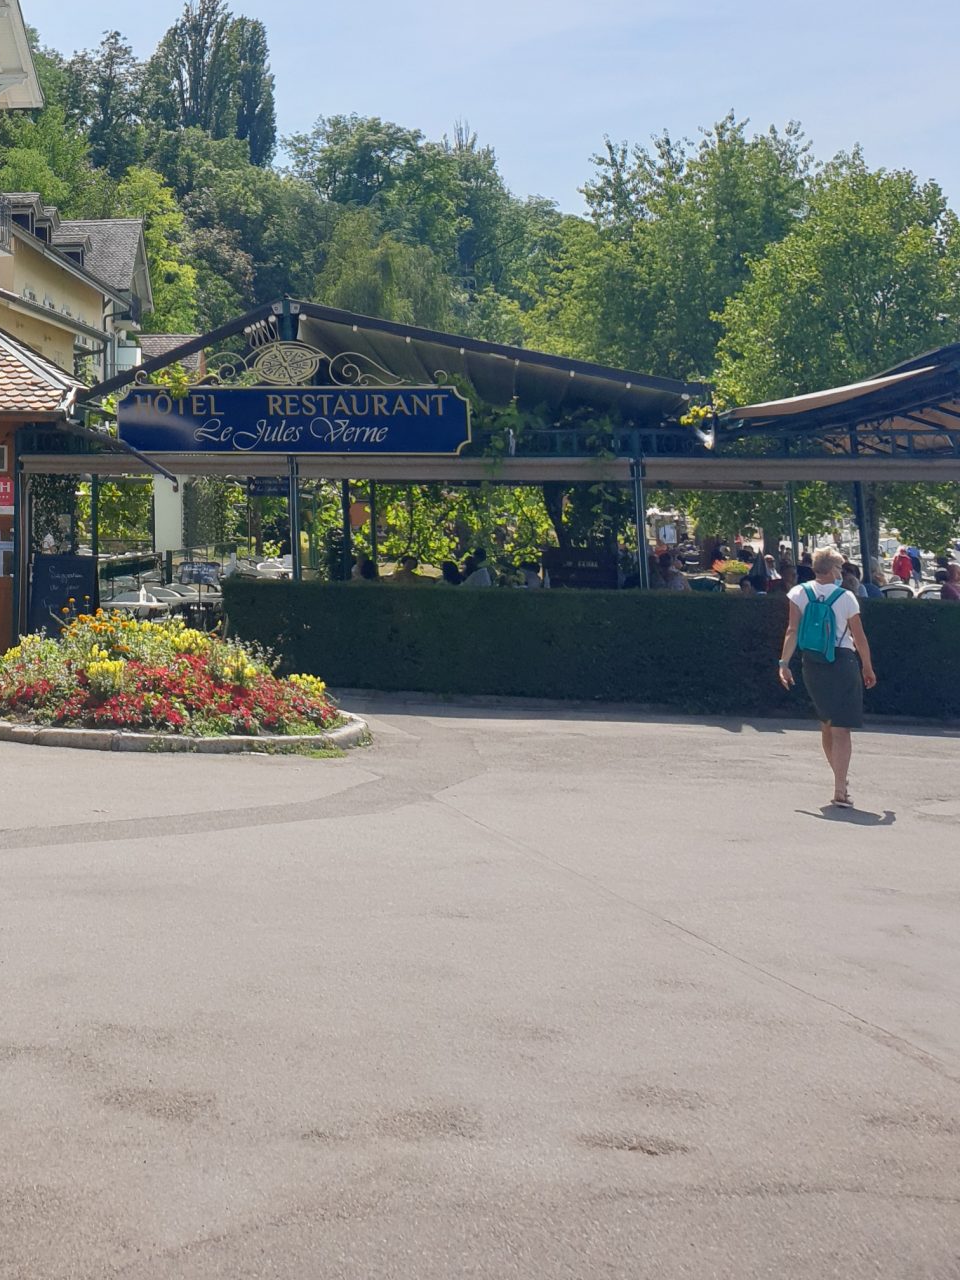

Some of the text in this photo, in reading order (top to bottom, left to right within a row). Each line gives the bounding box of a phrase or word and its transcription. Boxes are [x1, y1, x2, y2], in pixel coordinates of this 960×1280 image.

[266, 393, 449, 416] RESTAURANT
[193, 416, 389, 451] Le Jules Verne
[0, 481, 11, 493] H
